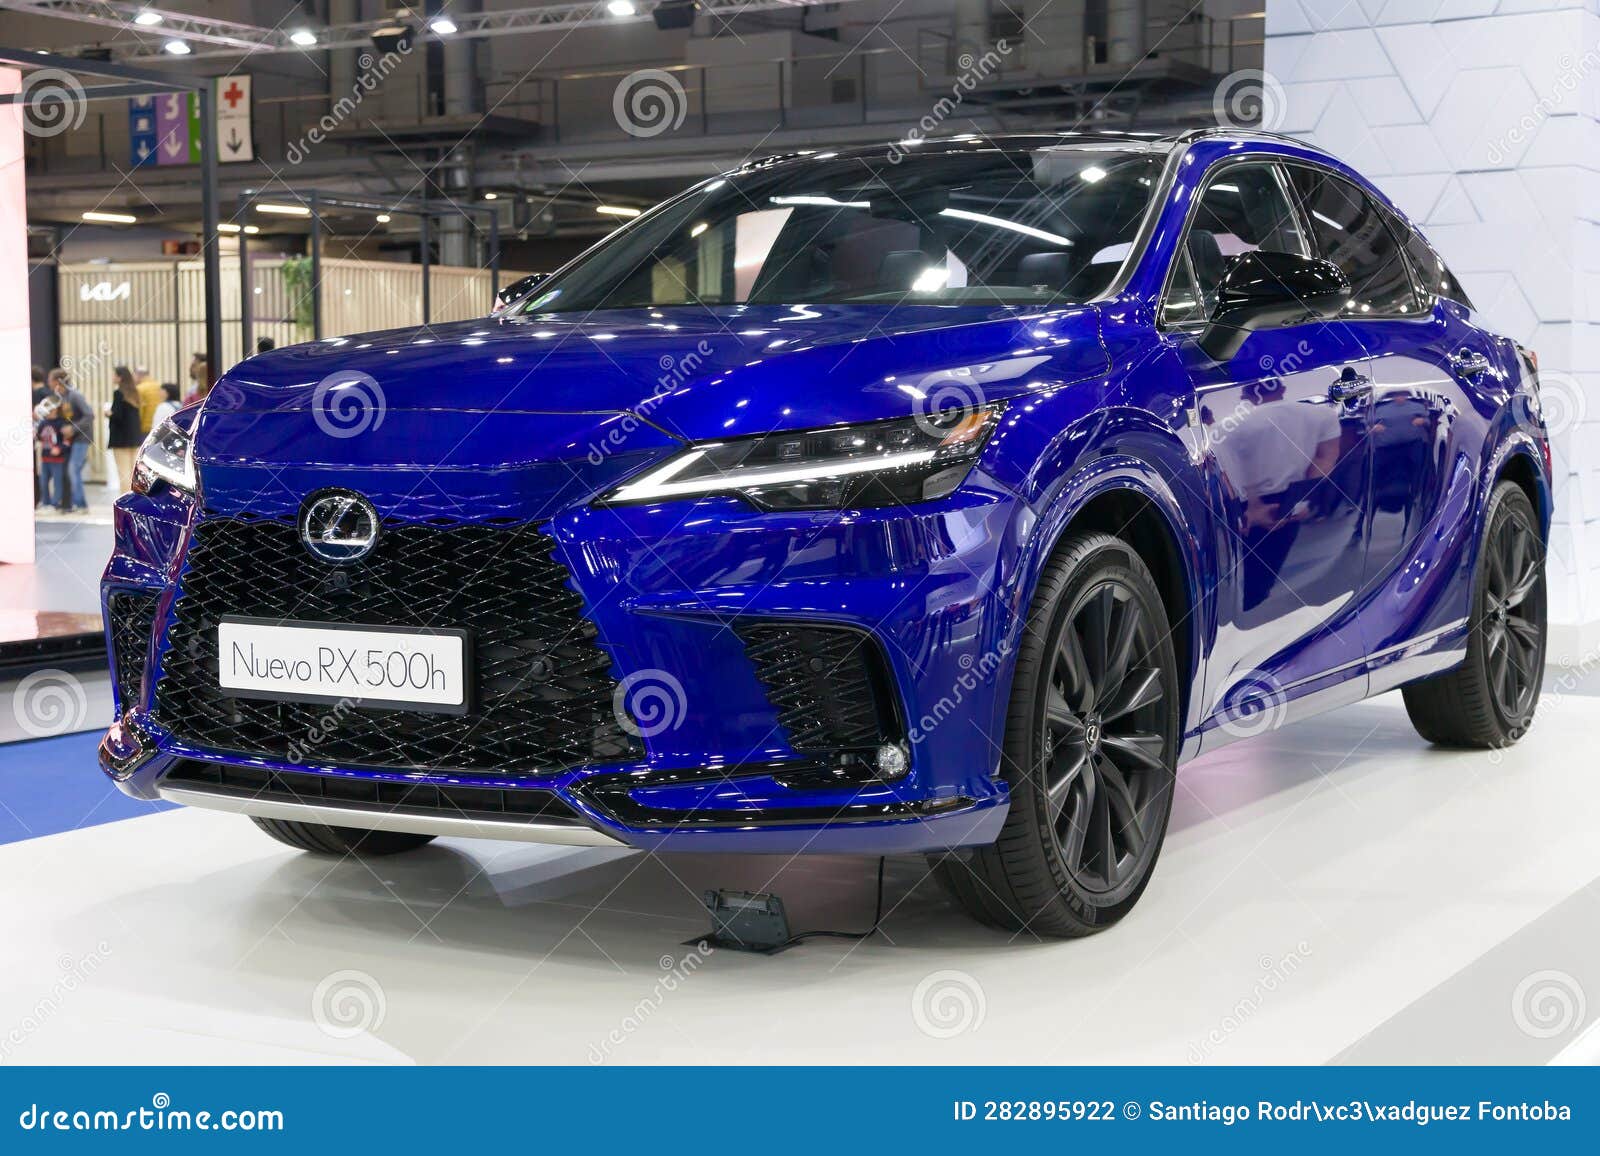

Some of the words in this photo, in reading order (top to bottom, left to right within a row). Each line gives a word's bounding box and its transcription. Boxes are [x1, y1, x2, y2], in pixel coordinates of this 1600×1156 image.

[232, 640, 312, 682] Nuevo
[318, 646, 360, 685] RX
[366, 649, 446, 691] 500h
